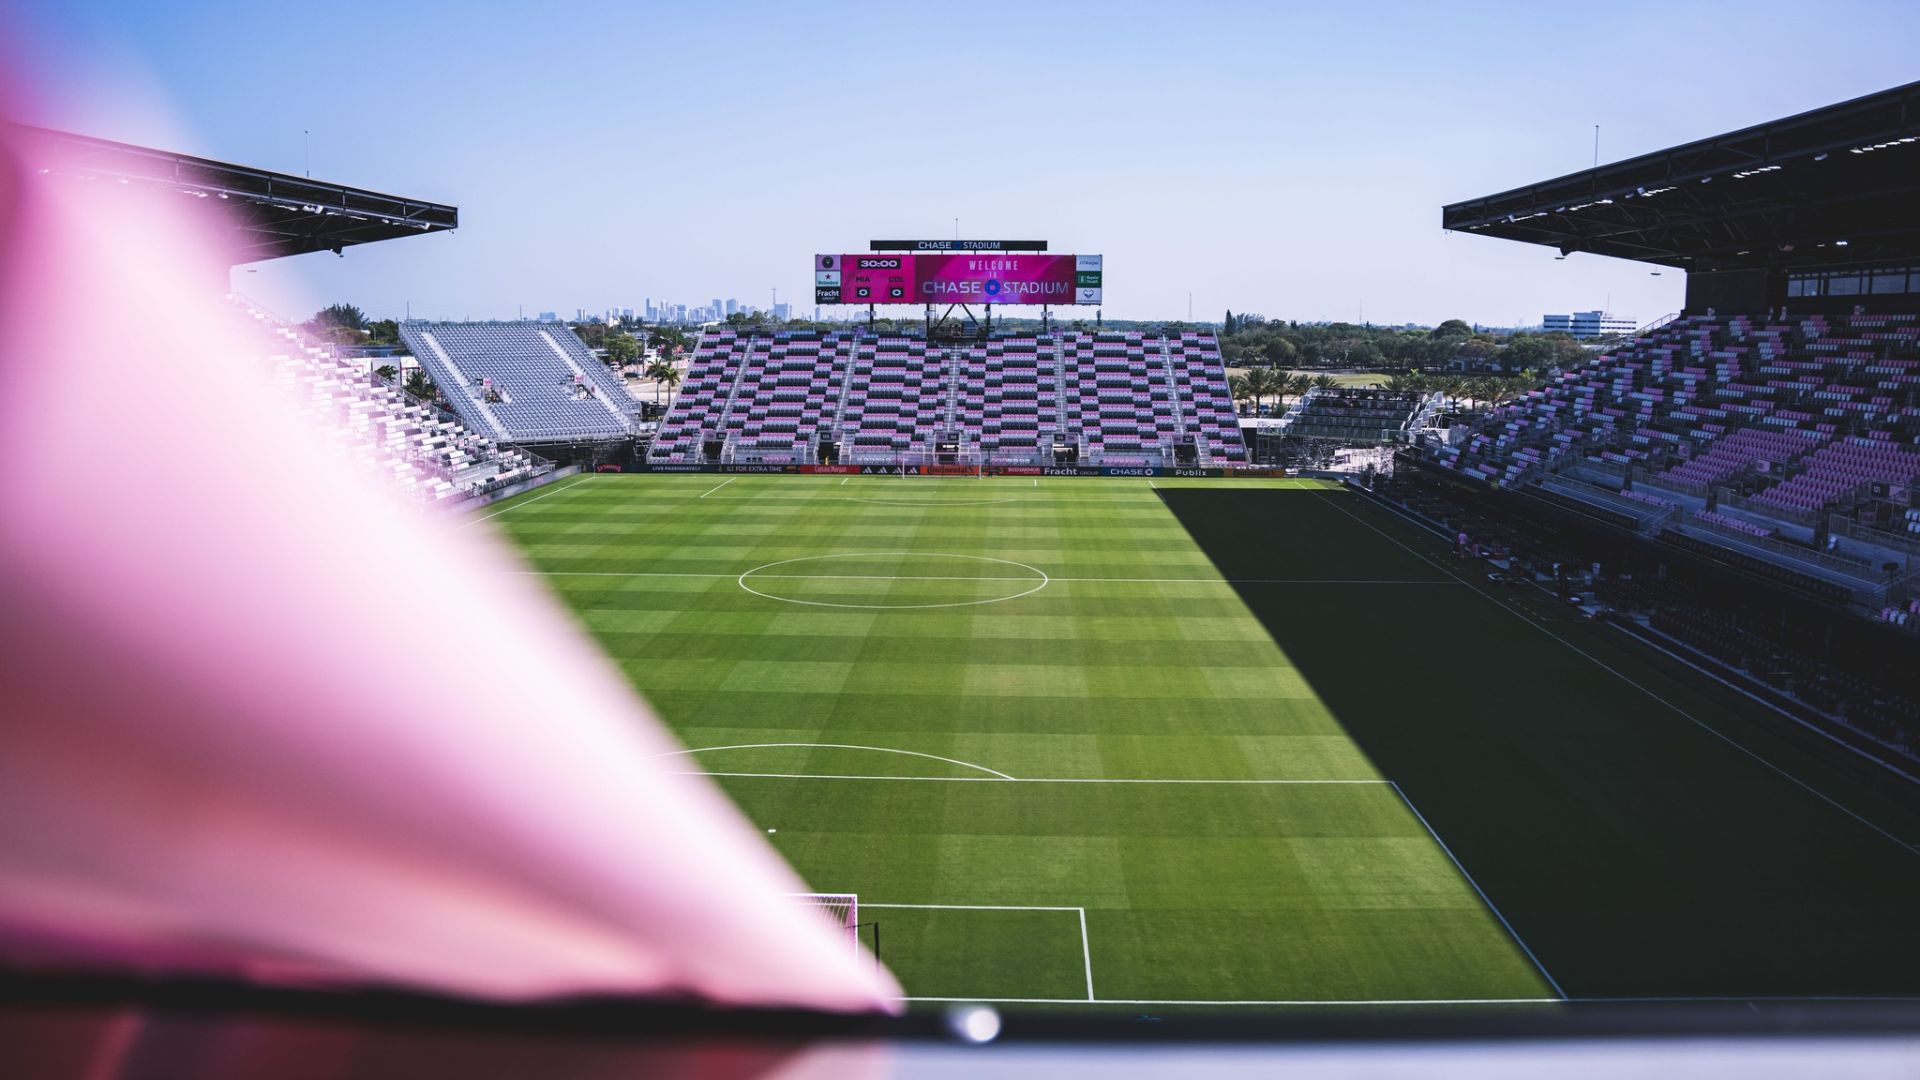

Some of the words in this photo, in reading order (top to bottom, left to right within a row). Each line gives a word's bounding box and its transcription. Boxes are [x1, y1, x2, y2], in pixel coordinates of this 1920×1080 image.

[918, 241, 951, 249] CHASE
[963, 241, 1001, 249] STADIUM
[860, 260, 898, 268] 30:00
[968, 260, 1019, 271] WELCOME
[922, 281, 982, 294] CHASE
[1003, 281, 1069, 294] STADIUM
[816, 289, 840, 297] Fracht
[858, 288, 868, 296] 0
[891, 288, 902, 296] 0
[1044, 467, 1078, 475] Fracht
